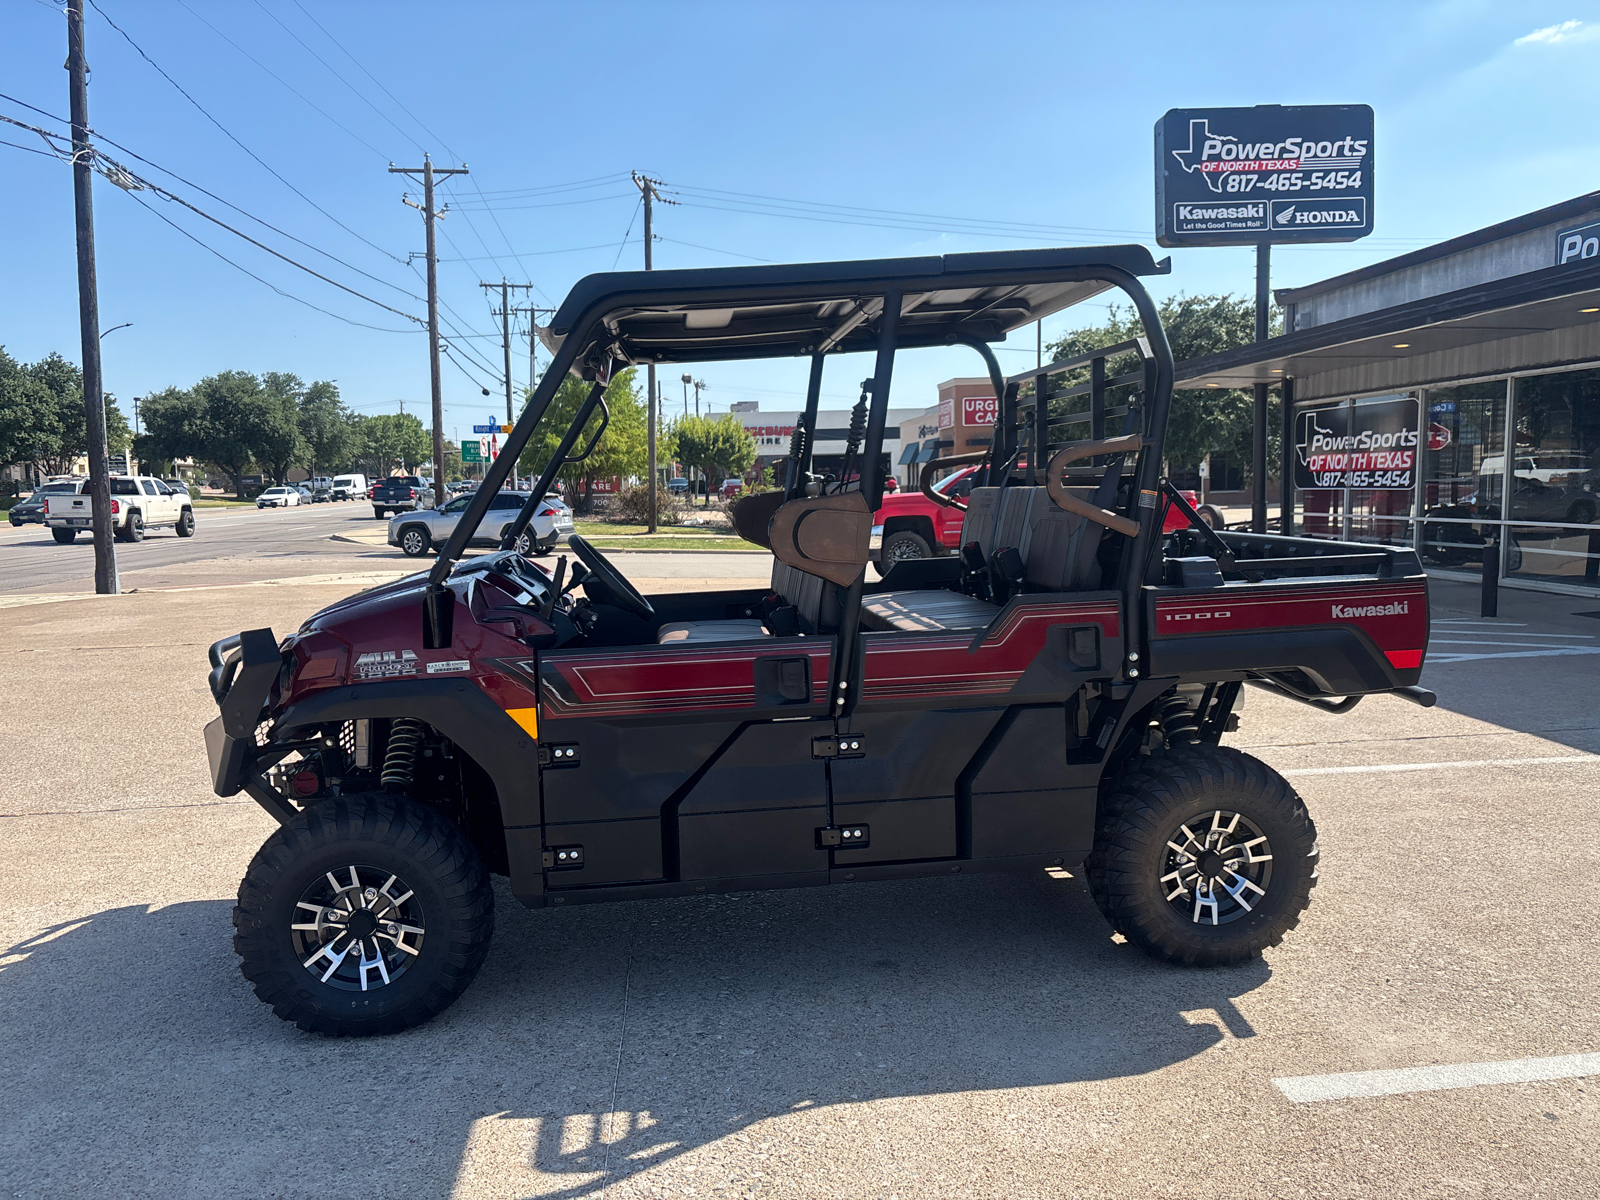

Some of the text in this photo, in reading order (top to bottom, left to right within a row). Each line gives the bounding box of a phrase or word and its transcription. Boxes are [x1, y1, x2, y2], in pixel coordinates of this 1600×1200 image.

[1202, 136, 1367, 162] PowerSports
[1202, 160, 1297, 172] OF NORTH TEXAS
[1227, 171, 1362, 192] 817-465-5454
[1179, 204, 1264, 220] Kawasaki
[1295, 210, 1360, 224] HONDA
[1312, 427, 1419, 452] PowerSports
[1310, 455, 1325, 471] OF
[1370, 451, 1411, 469] TEXAS
[1165, 610, 1231, 621] 1000
[1331, 601, 1409, 618] Kawasaki
[354, 649, 420, 667] MULE
